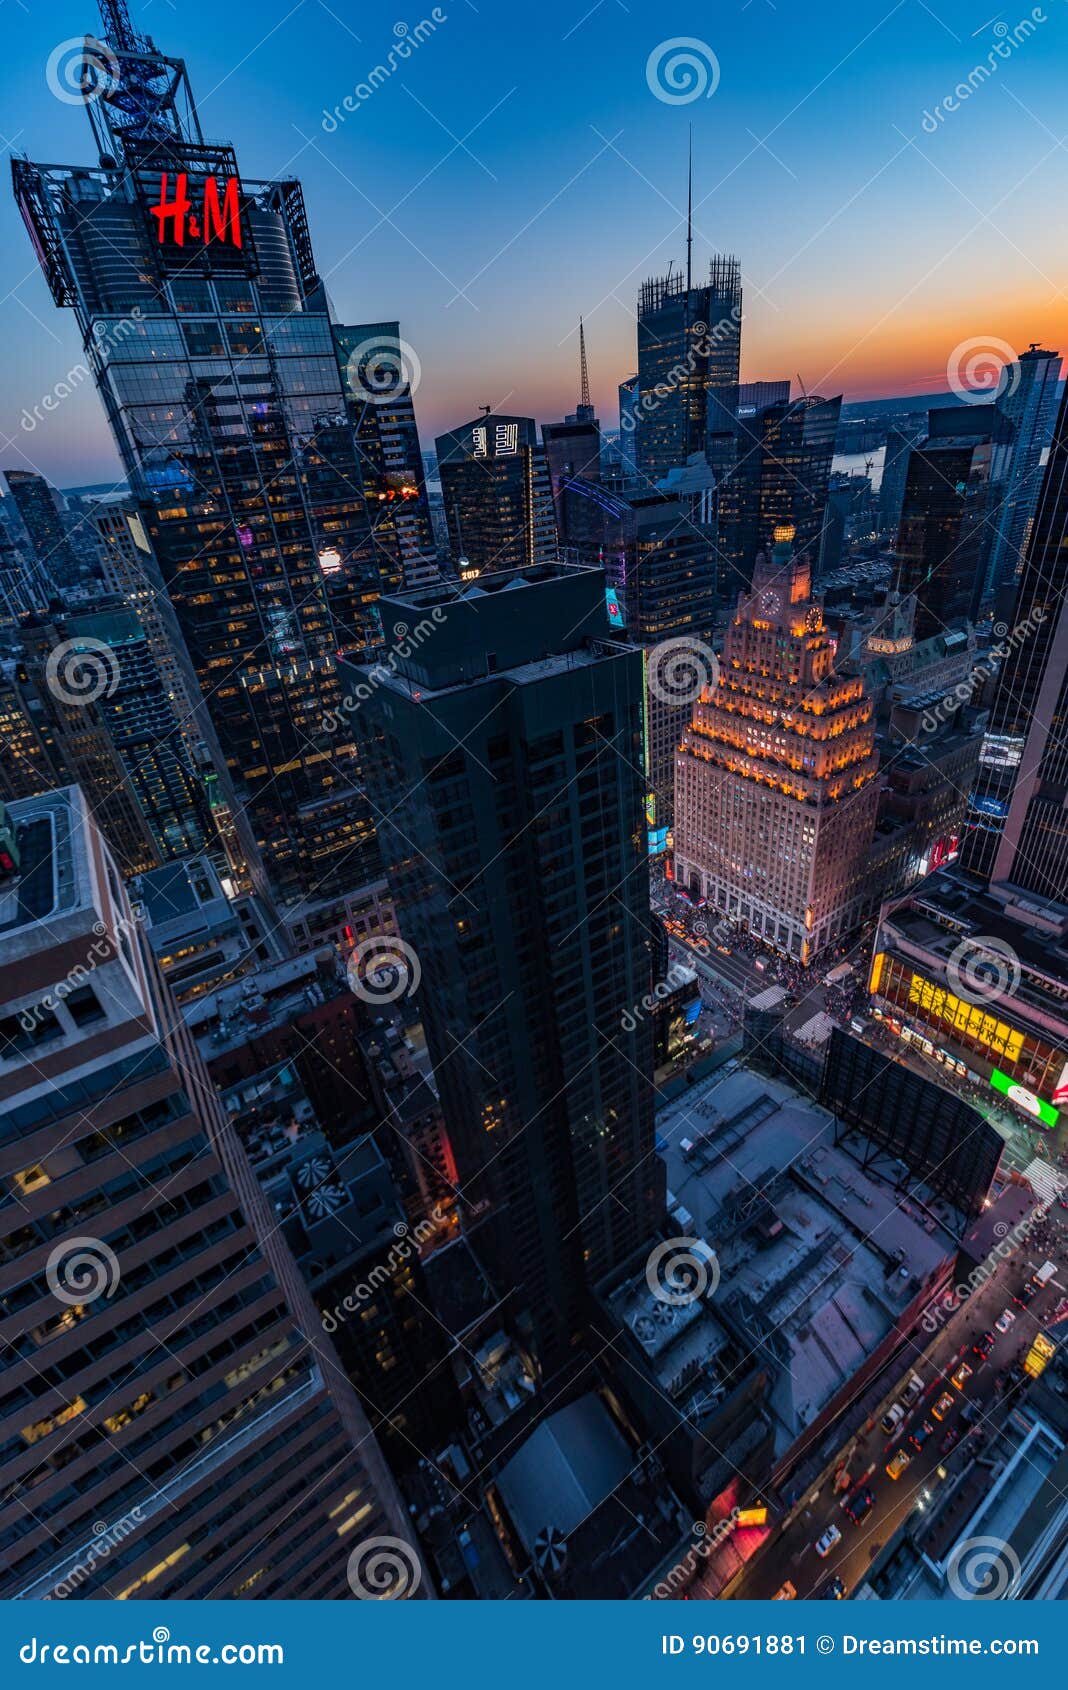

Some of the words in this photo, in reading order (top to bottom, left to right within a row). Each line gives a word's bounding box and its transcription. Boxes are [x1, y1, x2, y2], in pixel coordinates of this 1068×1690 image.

[149, 172, 242, 249] H&M
[461, 569, 480, 580] 2017
[958, 1013, 985, 1034] LION
